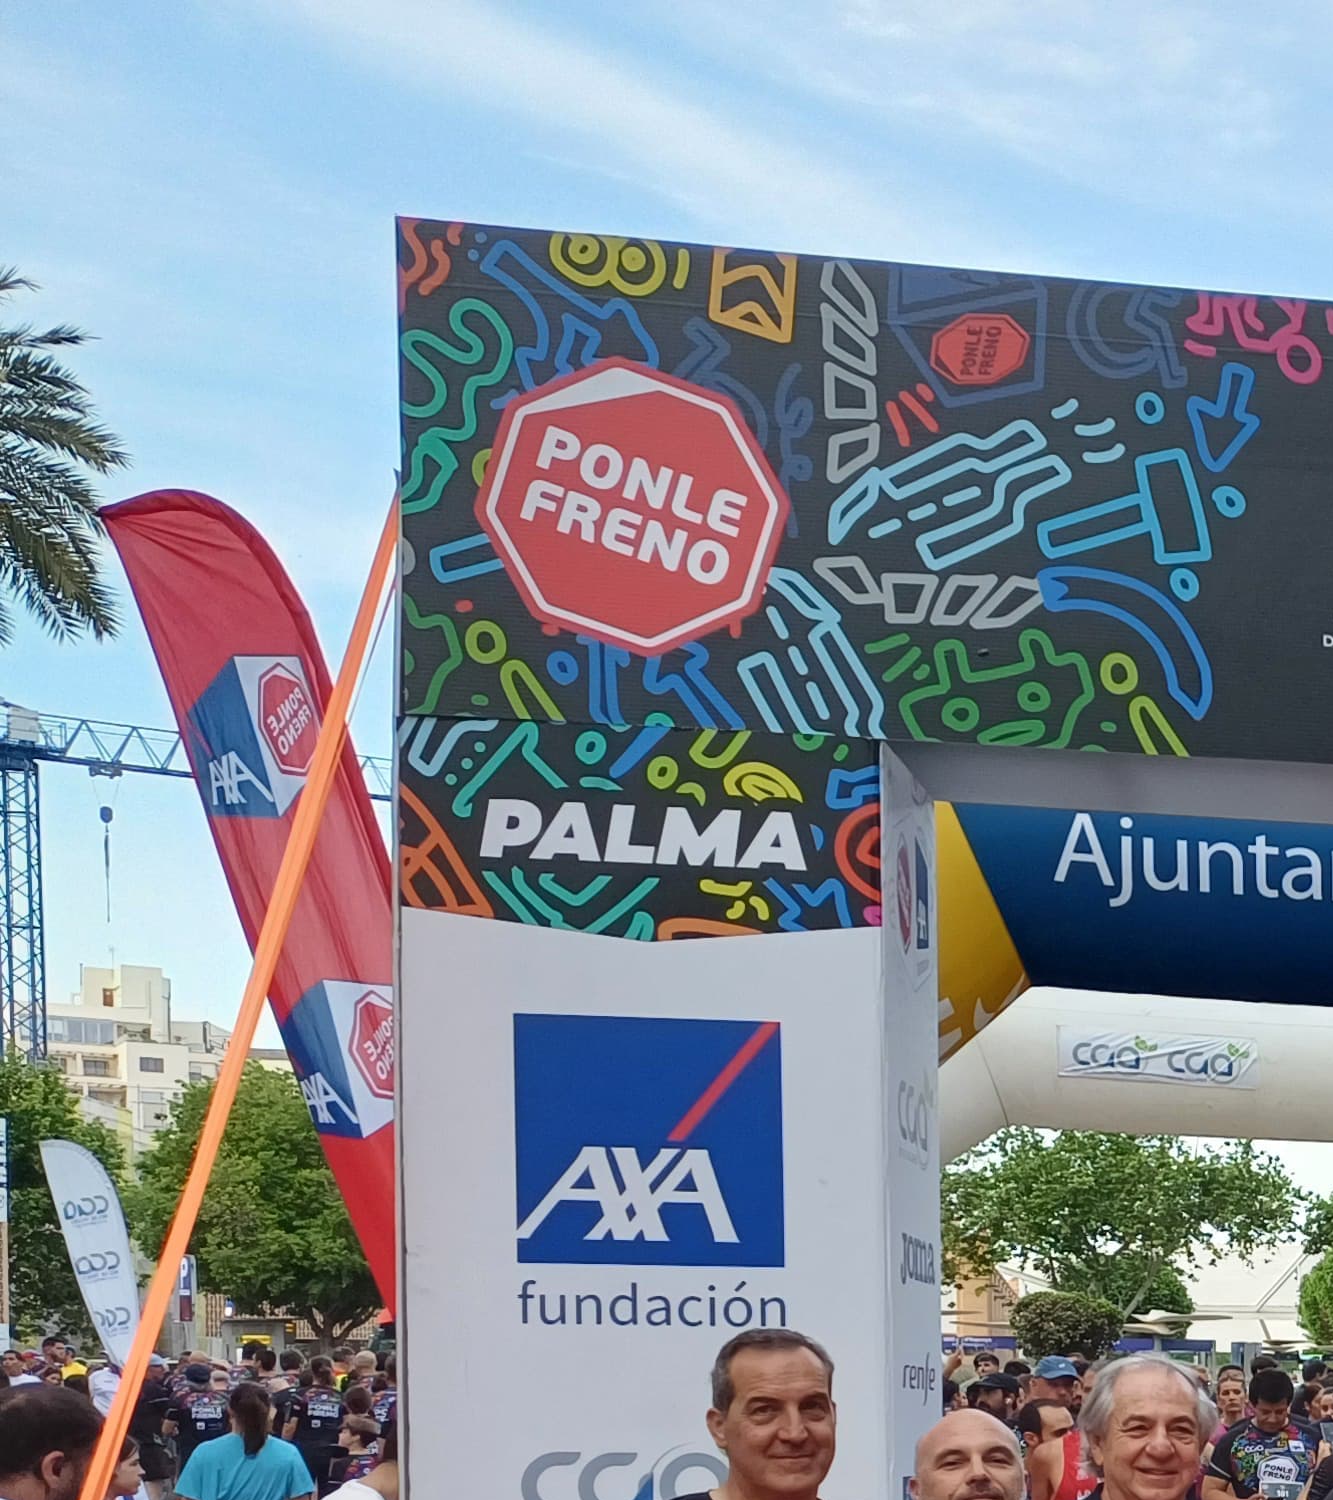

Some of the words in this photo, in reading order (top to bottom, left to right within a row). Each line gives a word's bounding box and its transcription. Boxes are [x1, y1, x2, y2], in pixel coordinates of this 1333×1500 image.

[978, 326, 1002, 376] FRENO
[536, 425, 748, 538] PONLE
[519, 480, 731, 585] FRENO
[479, 798, 807, 872] PALMA
[516, 1146, 741, 1243] AXA
[518, 1280, 787, 1327] fundación
